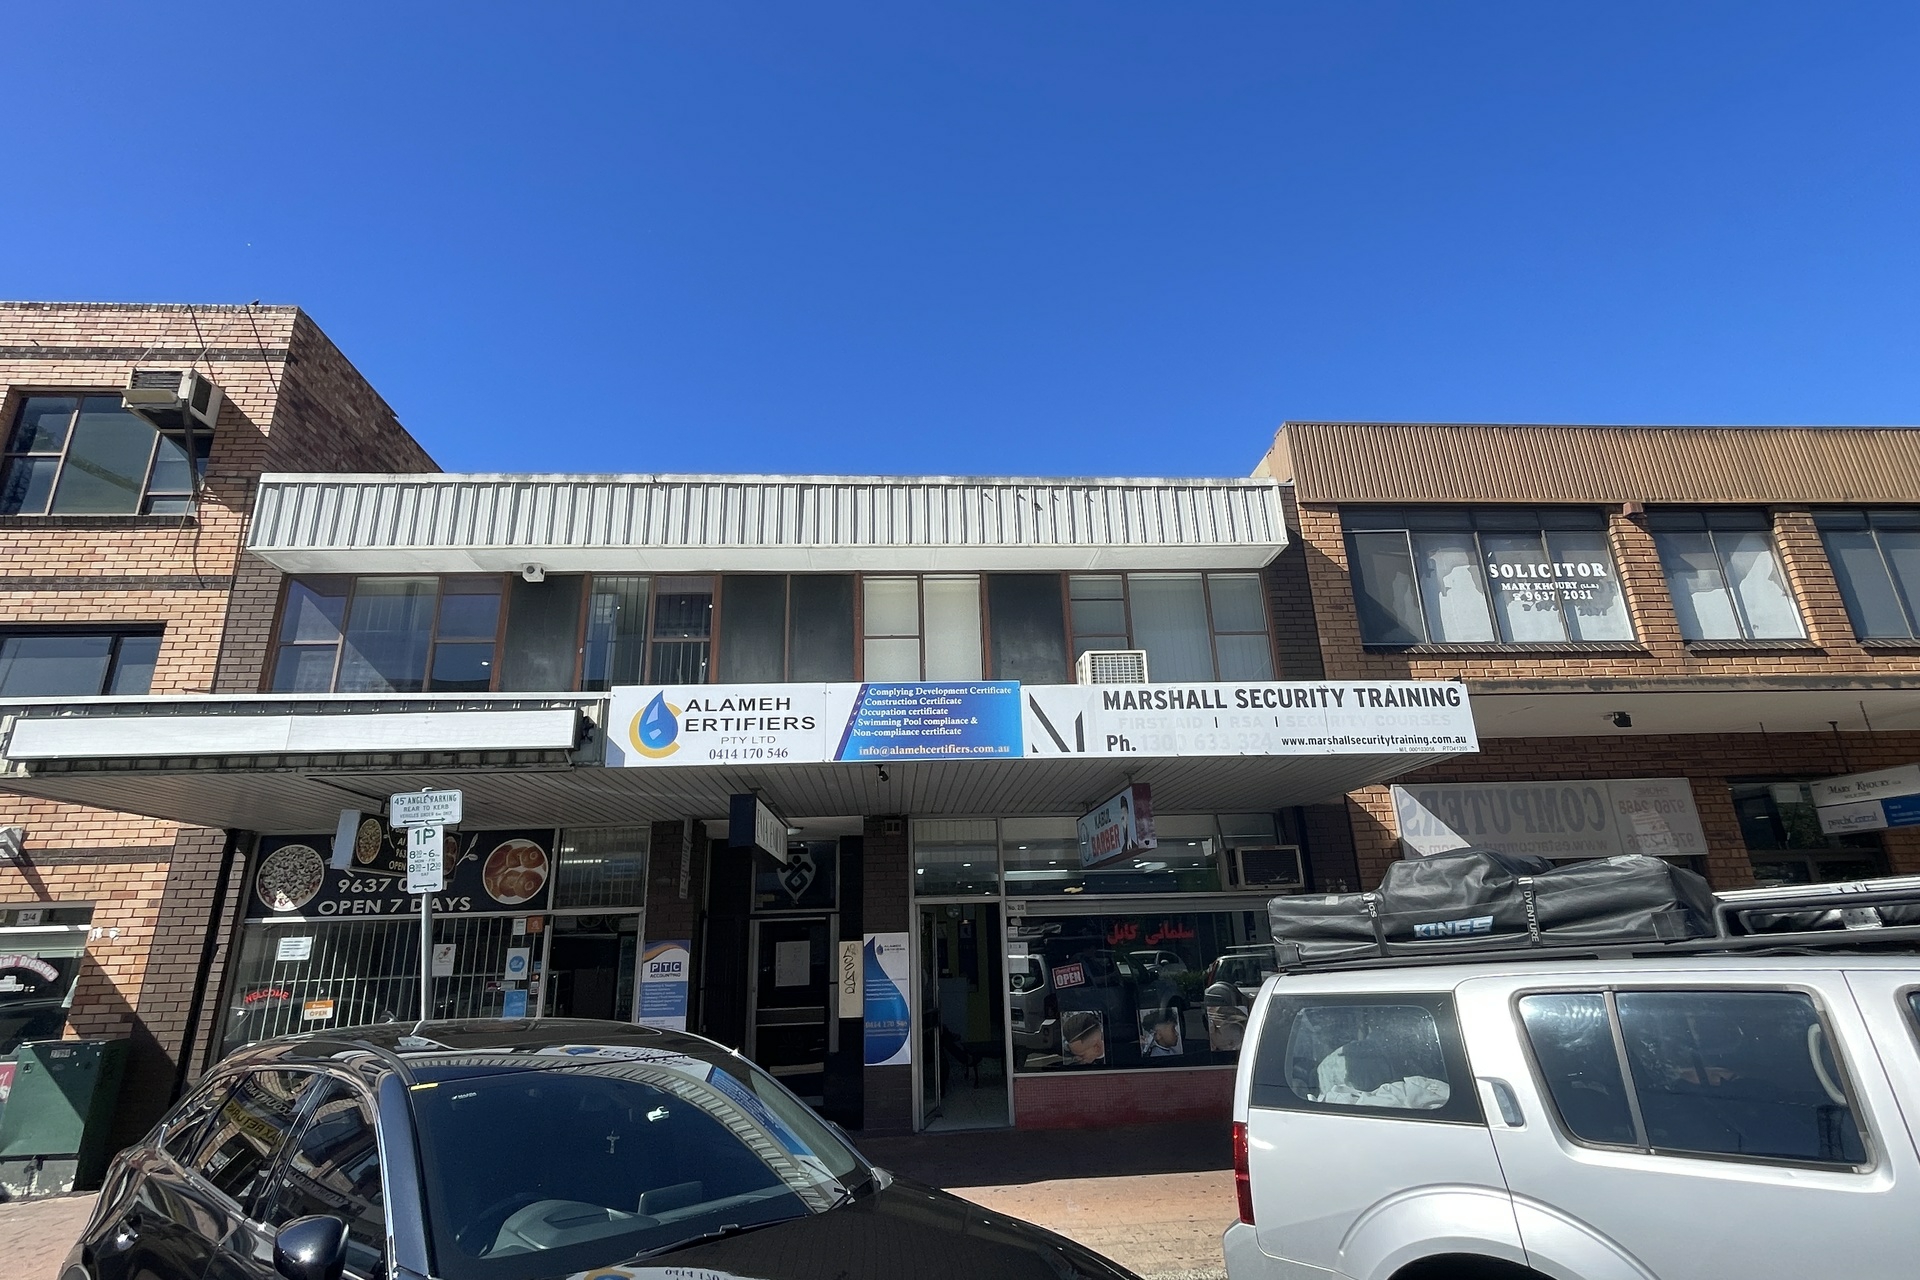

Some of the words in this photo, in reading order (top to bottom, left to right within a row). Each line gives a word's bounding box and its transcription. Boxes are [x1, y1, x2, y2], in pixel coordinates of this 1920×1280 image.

[1489, 562, 1607, 578] SOLICITOR
[1501, 582, 1532, 591] MARY
[1526, 590, 1556, 601] 9637
[1563, 589, 1593, 600] 2031
[869, 687, 914, 698] Complying
[915, 686, 968, 698] Development
[969, 686, 1012, 695] Certificate
[1102, 689, 1228, 711] MARSHALL
[1235, 687, 1345, 710] SECURITY
[1353, 686, 1461, 708] TRAINING
[685, 697, 791, 712] ALAMEH
[865, 697, 918, 706] Construction
[919, 696, 962, 706] Certificate
[860, 707, 907, 718] Occupation
[908, 706, 949, 716] certificate
[857, 718, 902, 728] Swimming
[903, 717, 922, 727] Pool
[923, 716, 969, 727] compliance
[970, 717, 978, 725] &
[853, 728, 920, 739] Non-compliance
[921, 726, 962, 736] certificate
[720, 736, 748, 745] PTY
[751, 736, 776, 744] LTD
[1106, 734, 1137, 752] Ph.
[1281, 734, 1467, 747] www.marshallsecuritytraining.com.au
[709, 748, 738, 760] 0414
[743, 747, 763, 759] 170
[767, 747, 789, 759] 546
[859, 744, 1010, 757] info@alamehcertifiers.com.au
[407, 796, 427, 805] ANGLE
[430, 793, 457, 804] PARKING
[403, 805, 420, 813] REAR
[423, 804, 431, 812] TO
[433, 803, 450, 811] KERB
[414, 828, 436, 846] 1P
[337, 878, 392, 894] 9637
[317, 899, 382, 915] OPEN
[389, 898, 404, 914] 7
[410, 896, 472, 913] DAYS
[1413, 915, 1494, 939] KINGS
[650, 962, 681, 972] PTC
[1056, 970, 1082, 986] OPEN
[244, 989, 290, 1004] WELCOME
